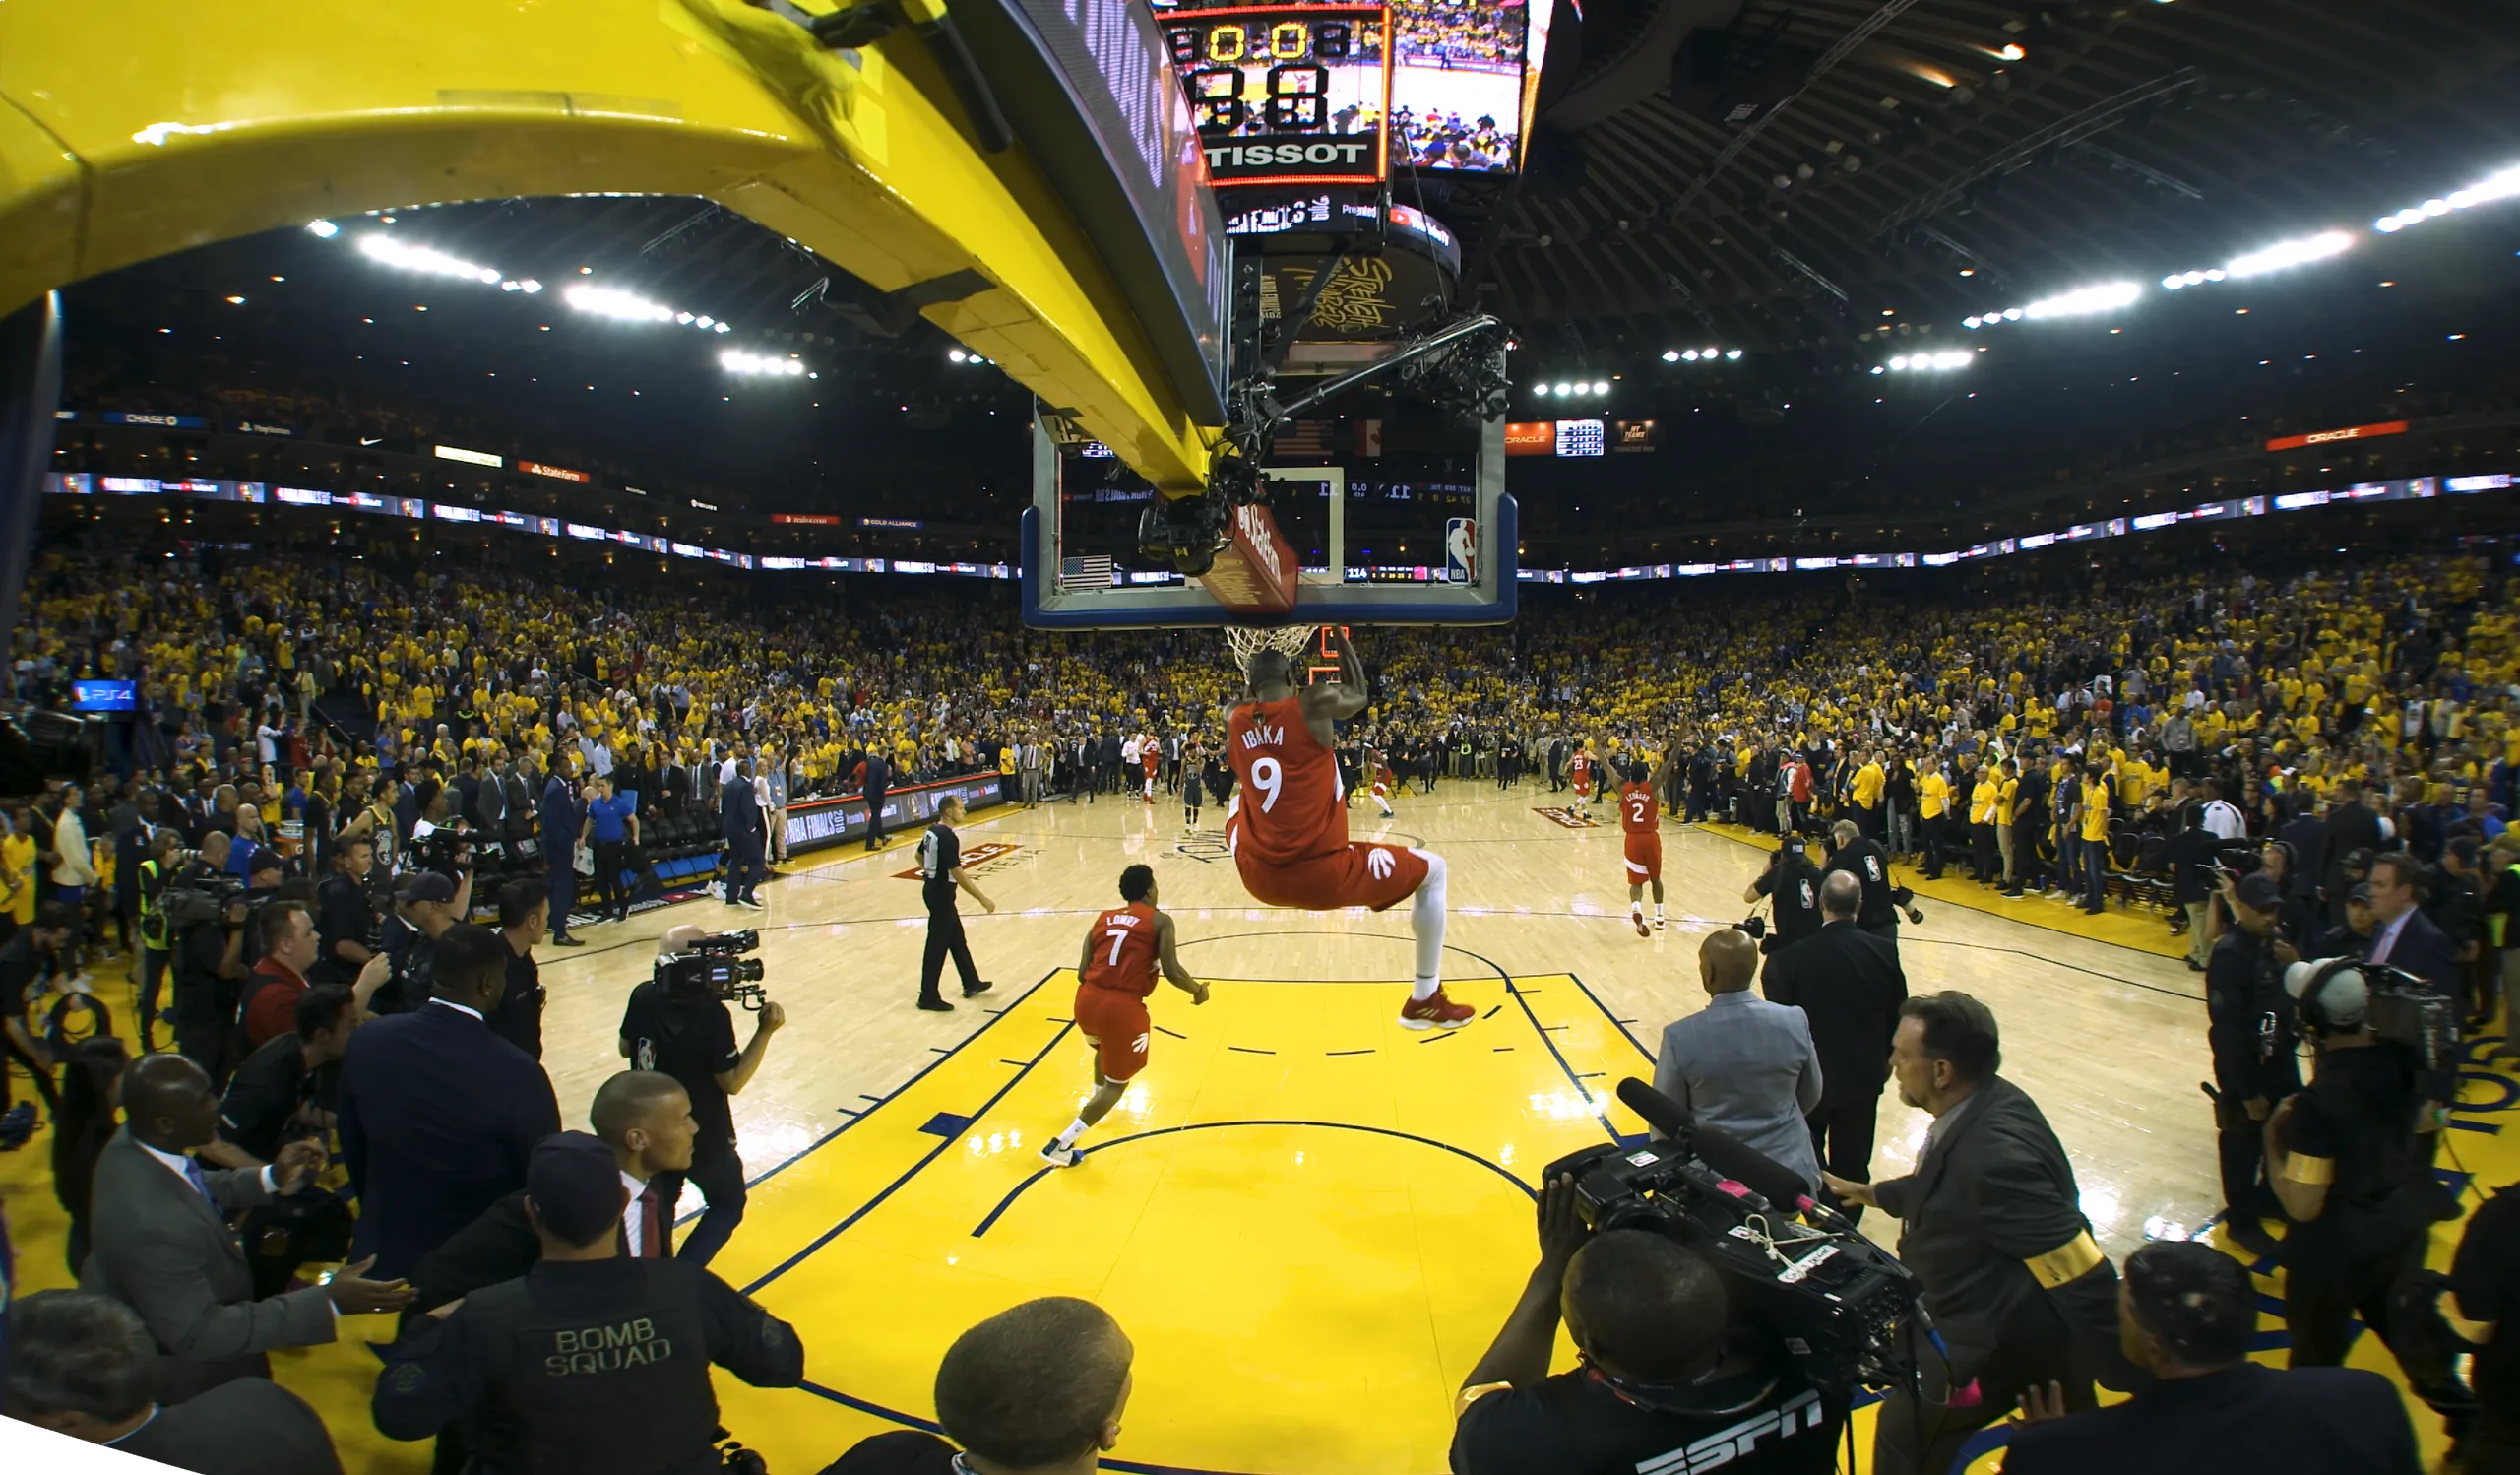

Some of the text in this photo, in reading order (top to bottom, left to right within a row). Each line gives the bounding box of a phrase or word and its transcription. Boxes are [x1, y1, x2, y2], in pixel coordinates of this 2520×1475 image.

[1204, 144, 1367, 167] TISSOT
[126, 414, 166, 425] CHASE
[2305, 427, 2361, 444] ORACLE
[1347, 567, 1368, 579] 114
[1451, 568, 1465, 580] NBA
[91, 689, 135, 701] PS4
[1241, 725, 1284, 749] IBAKA
[1574, 759, 1584, 770] 23
[1251, 757, 1282, 814] 9
[1632, 802, 1644, 822] 2
[788, 816, 808, 844] NBA
[806, 811, 836, 840] FINALS
[833, 809, 846, 834] 2019
[1106, 914, 1141, 928] LOWRY
[1106, 929, 1129, 966] 7
[555, 1317, 655, 1354] BOMB
[544, 1338, 671, 1377] SQUAD
[1635, 1388, 1823, 1475] ESPN
